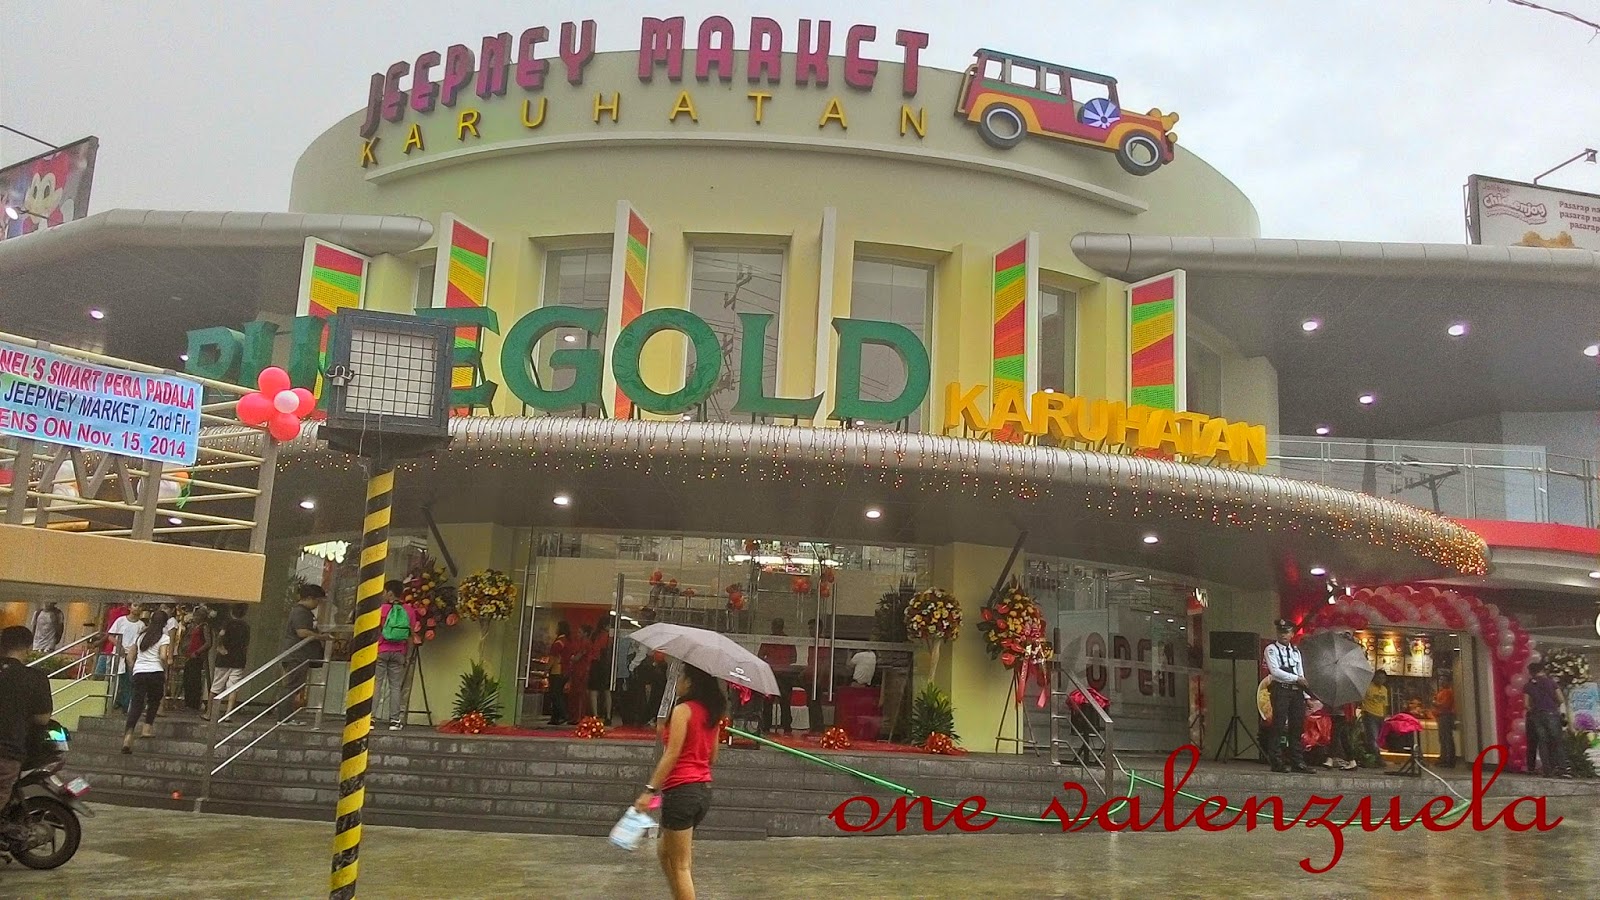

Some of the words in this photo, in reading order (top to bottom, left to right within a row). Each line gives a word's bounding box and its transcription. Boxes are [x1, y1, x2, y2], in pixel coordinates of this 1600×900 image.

[360, 19, 597, 138] JEEPNEY
[638, 15, 929, 97] MARKET
[361, 89, 927, 168] KARUHATAN
[1559, 201, 1590, 213] Pasarap
[1559, 212, 1590, 223] pasarap
[48, 361, 102, 392] SMART
[104, 373, 142, 399] PERA
[146, 379, 194, 410] PADALA
[185, 306, 930, 422] PUEGOLD
[4, 380, 77, 413] JEEPNEY
[78, 395, 139, 425] MARKET
[147, 409, 172, 431] 2nd
[944, 382, 1267, 467] KARUHATAN
[44, 417, 72, 439] ON
[78, 423, 114, 446] Nov.
[122, 431, 144, 454] 15,
[150, 436, 185, 458] 2014
[1085, 632, 1176, 698] OPEN
